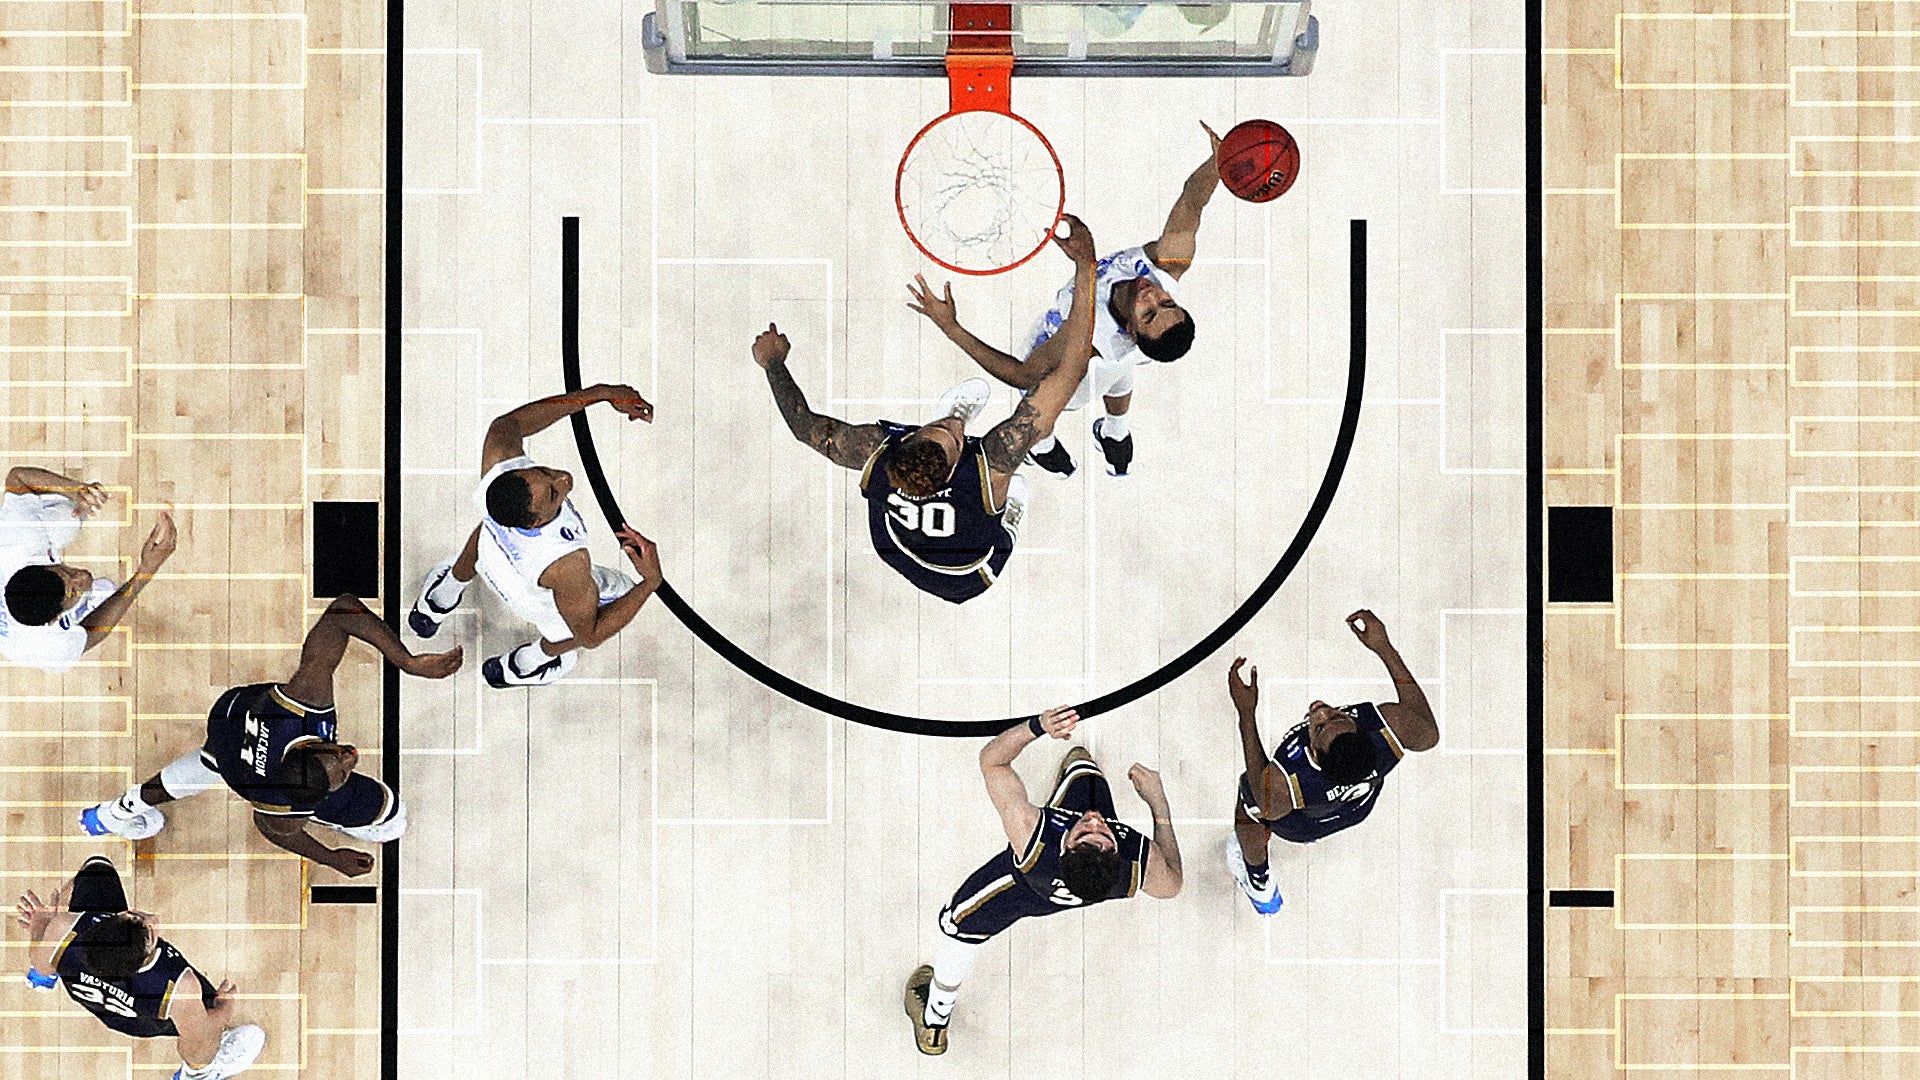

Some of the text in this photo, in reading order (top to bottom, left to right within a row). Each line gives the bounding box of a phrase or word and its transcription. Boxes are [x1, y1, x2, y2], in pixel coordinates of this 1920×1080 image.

[887, 493, 956, 538] 30
[240, 709, 259, 766] 11
[255, 721, 270, 777] JACKSON
[72, 983, 138, 1018] 32
